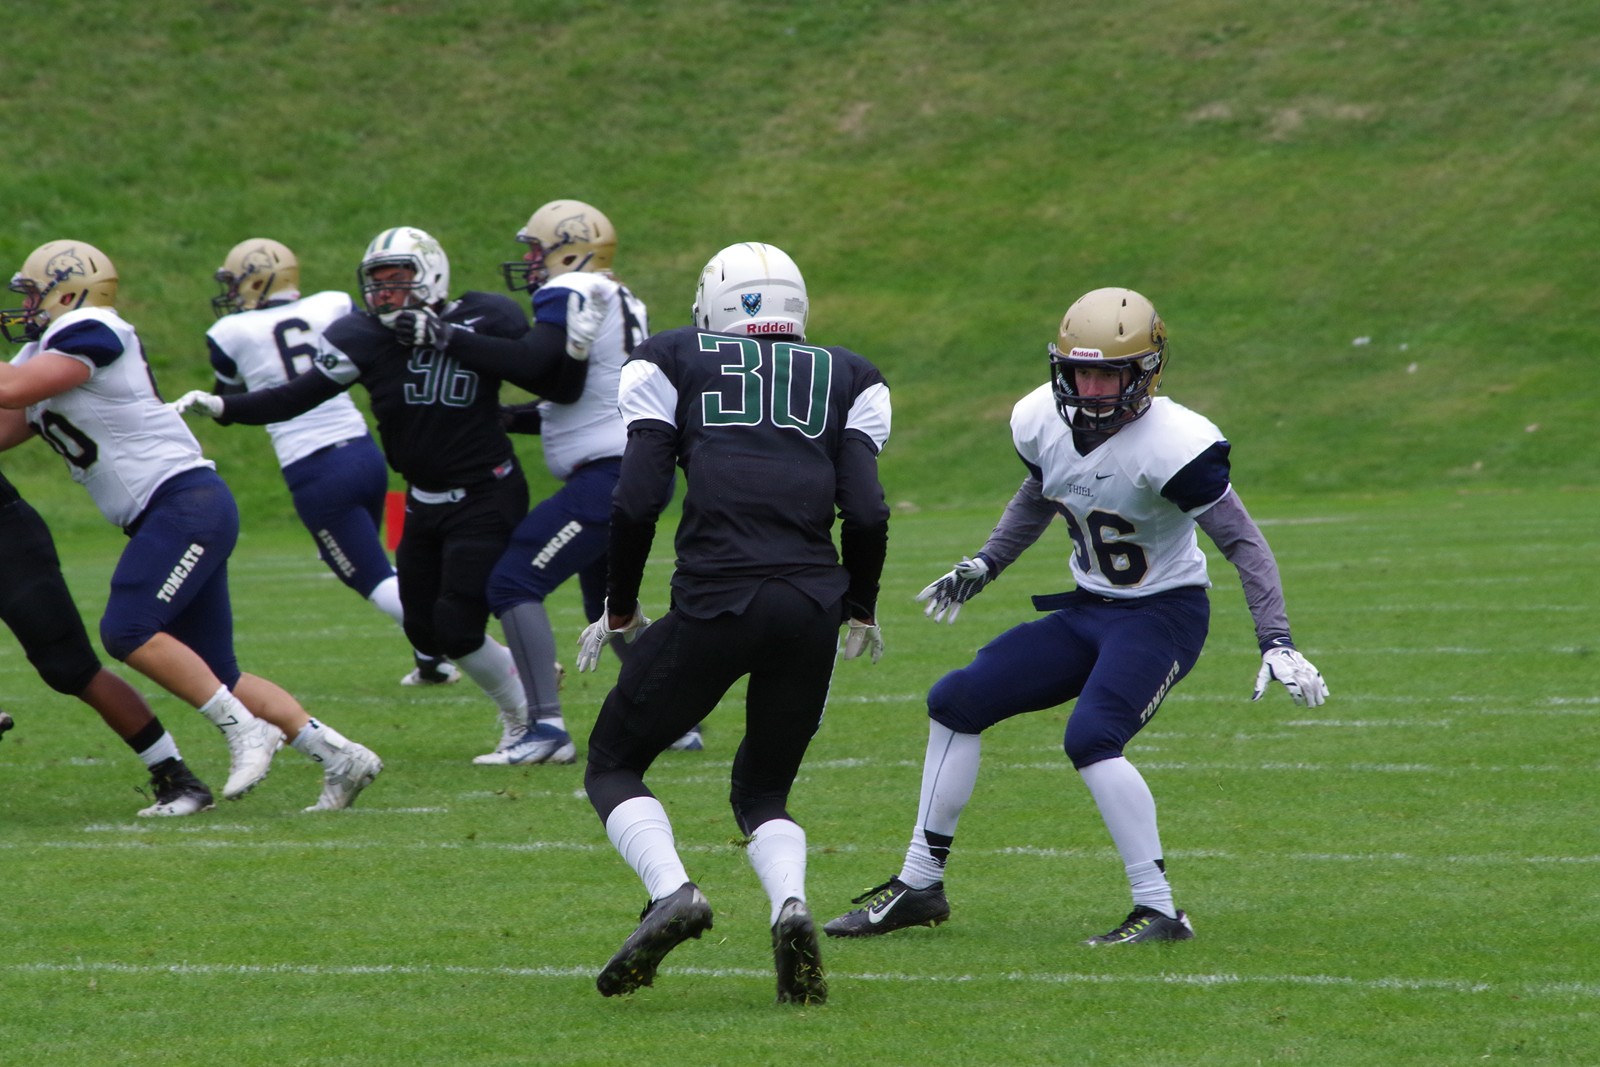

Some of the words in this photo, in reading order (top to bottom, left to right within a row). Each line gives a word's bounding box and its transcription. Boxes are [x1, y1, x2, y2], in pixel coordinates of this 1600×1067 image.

[746, 322, 794, 334] Riddell
[403, 347, 480, 407] 96
[1072, 350, 1100, 358] Riddell
[697, 332, 832, 439] 30
[1067, 483, 1094, 498] THIEL
[317, 528, 356, 578] TOMCATS
[530, 520, 583, 570] TOMCATS
[156, 543, 205, 603] TOMCATS
[1140, 660, 1180, 724] TOMCATS
